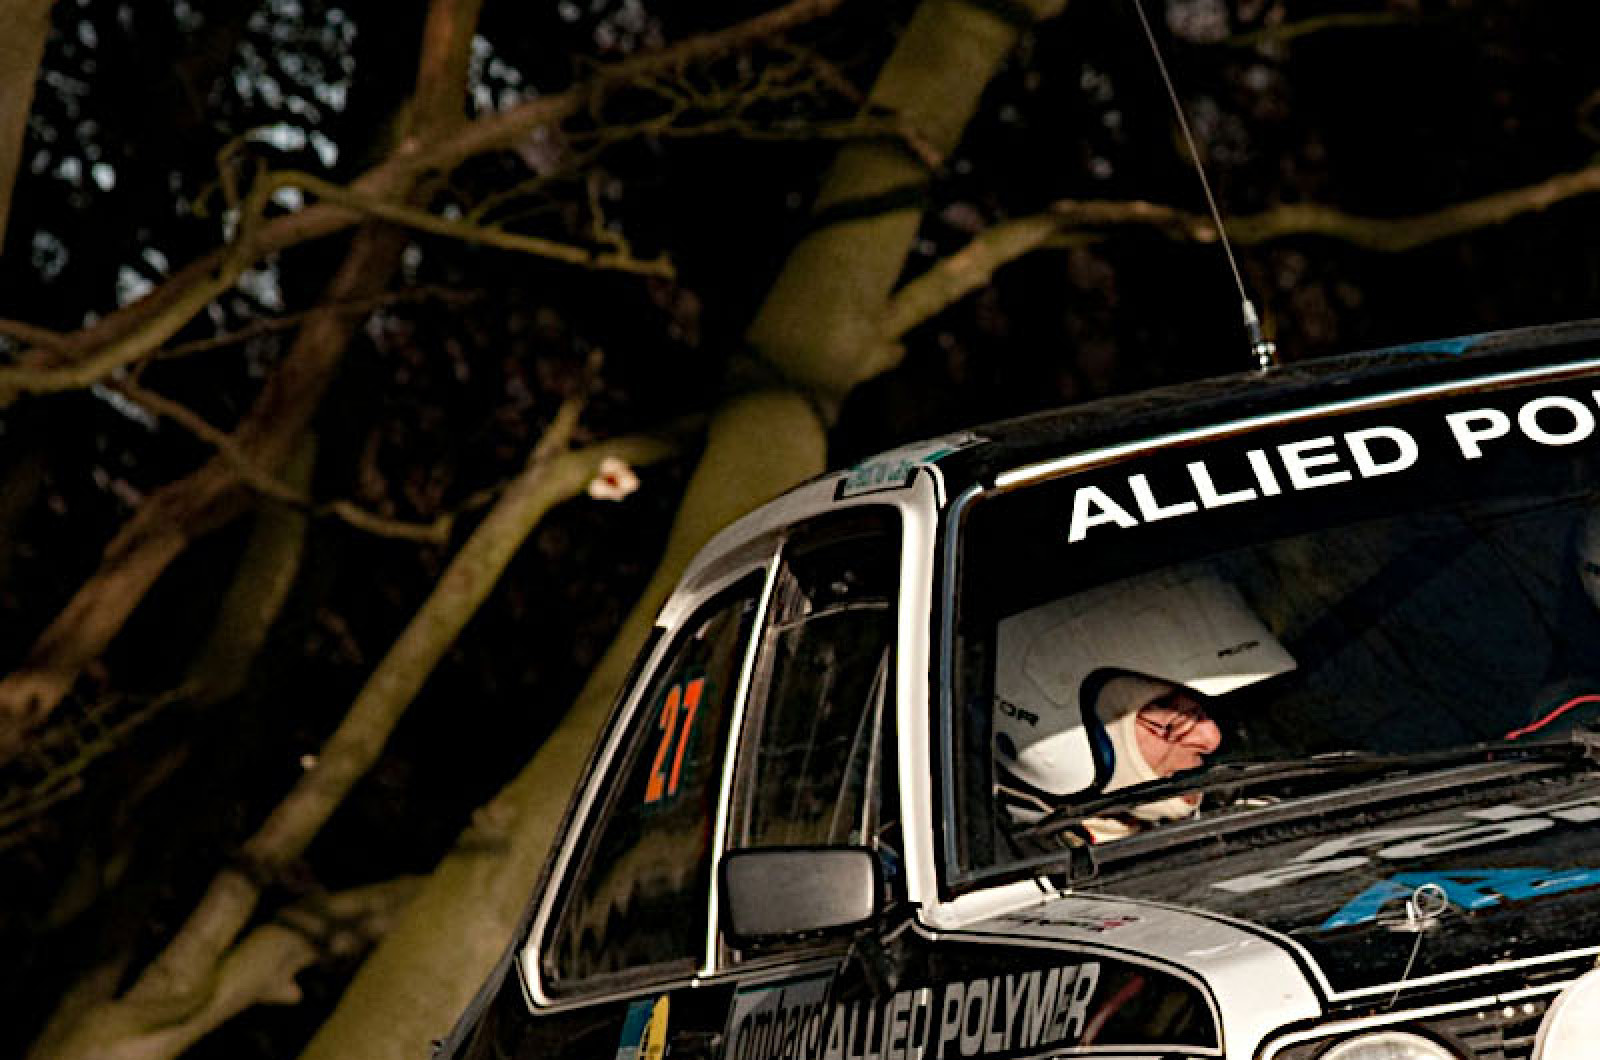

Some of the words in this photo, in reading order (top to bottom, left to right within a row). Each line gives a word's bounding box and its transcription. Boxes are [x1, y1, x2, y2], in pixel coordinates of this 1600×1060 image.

[1068, 426, 1419, 542] ALLIED
[645, 677, 706, 804] 27
[937, 962, 1101, 1060] POLYMER
